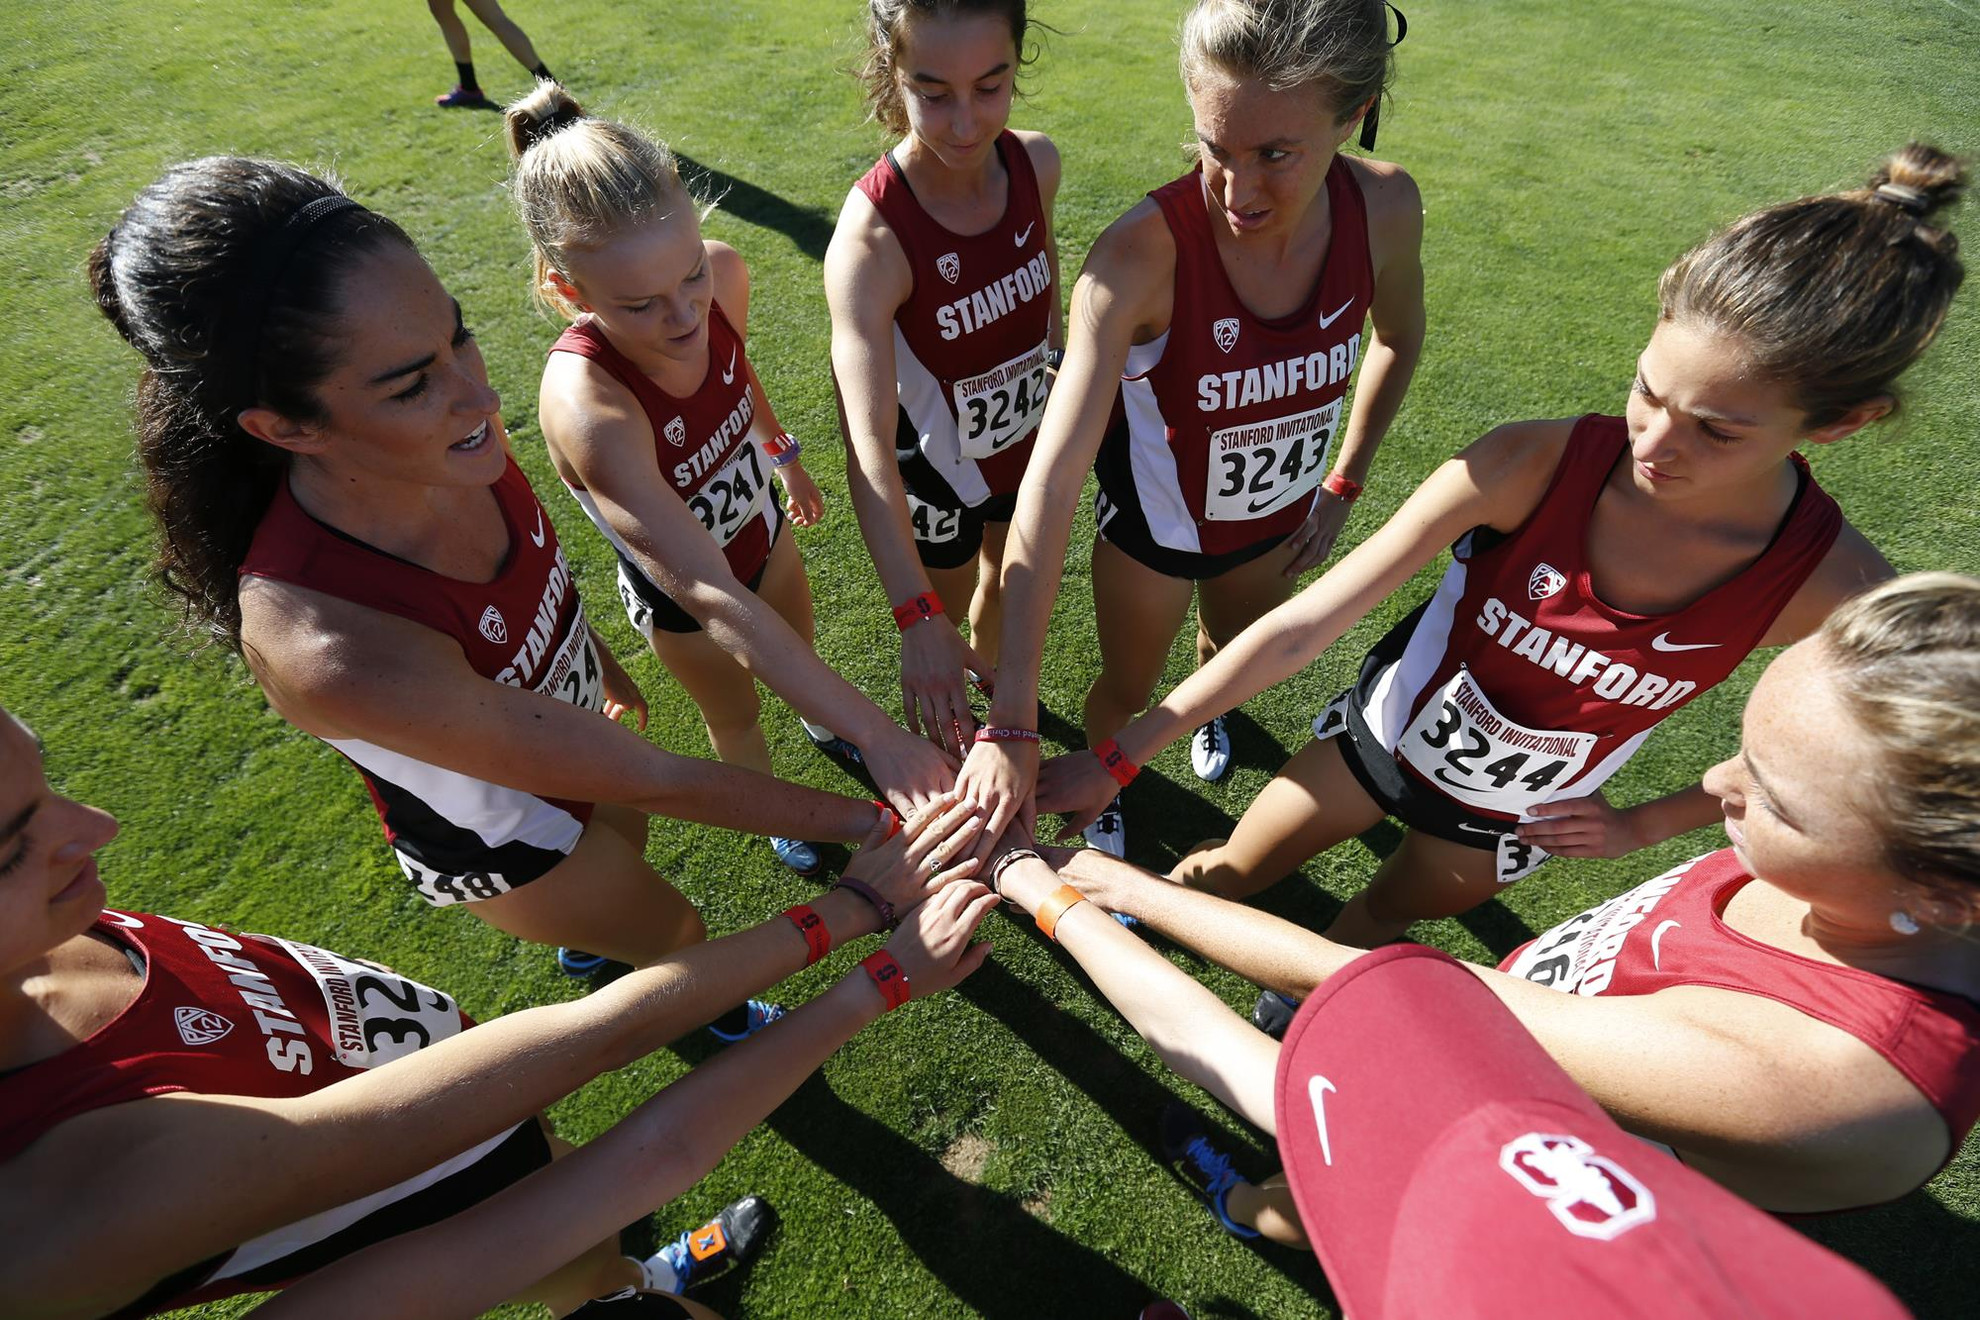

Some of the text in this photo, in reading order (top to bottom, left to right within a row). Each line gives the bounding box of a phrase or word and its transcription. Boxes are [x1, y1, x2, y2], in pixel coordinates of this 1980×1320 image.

[936, 249, 1052, 341] STANFORD
[1214, 319, 1239, 341] PAC
[962, 344, 1046, 398] STANFORD INVITATIONAL
[1197, 333, 1361, 412] STANFORD
[1219, 333, 1234, 346] 12
[966, 367, 1045, 440] 3242
[1220, 406, 1335, 452] STANFORD INVITATIONAL
[689, 440, 765, 532] 3247
[1218, 428, 1331, 498] 3243
[494, 546, 570, 689] STANFOR
[1530, 579, 1550, 597] 12
[562, 639, 598, 708] 24
[1475, 597, 1697, 711] STANFORD
[1419, 700, 1569, 792] 3244
[1451, 681, 1582, 758] STANFORD INVITATIONAL
[156, 914, 314, 1076] STANFO
[201, 1015, 226, 1034] 12
[325, 977, 364, 1053] STANFORD
[355, 975, 431, 1054] 32
